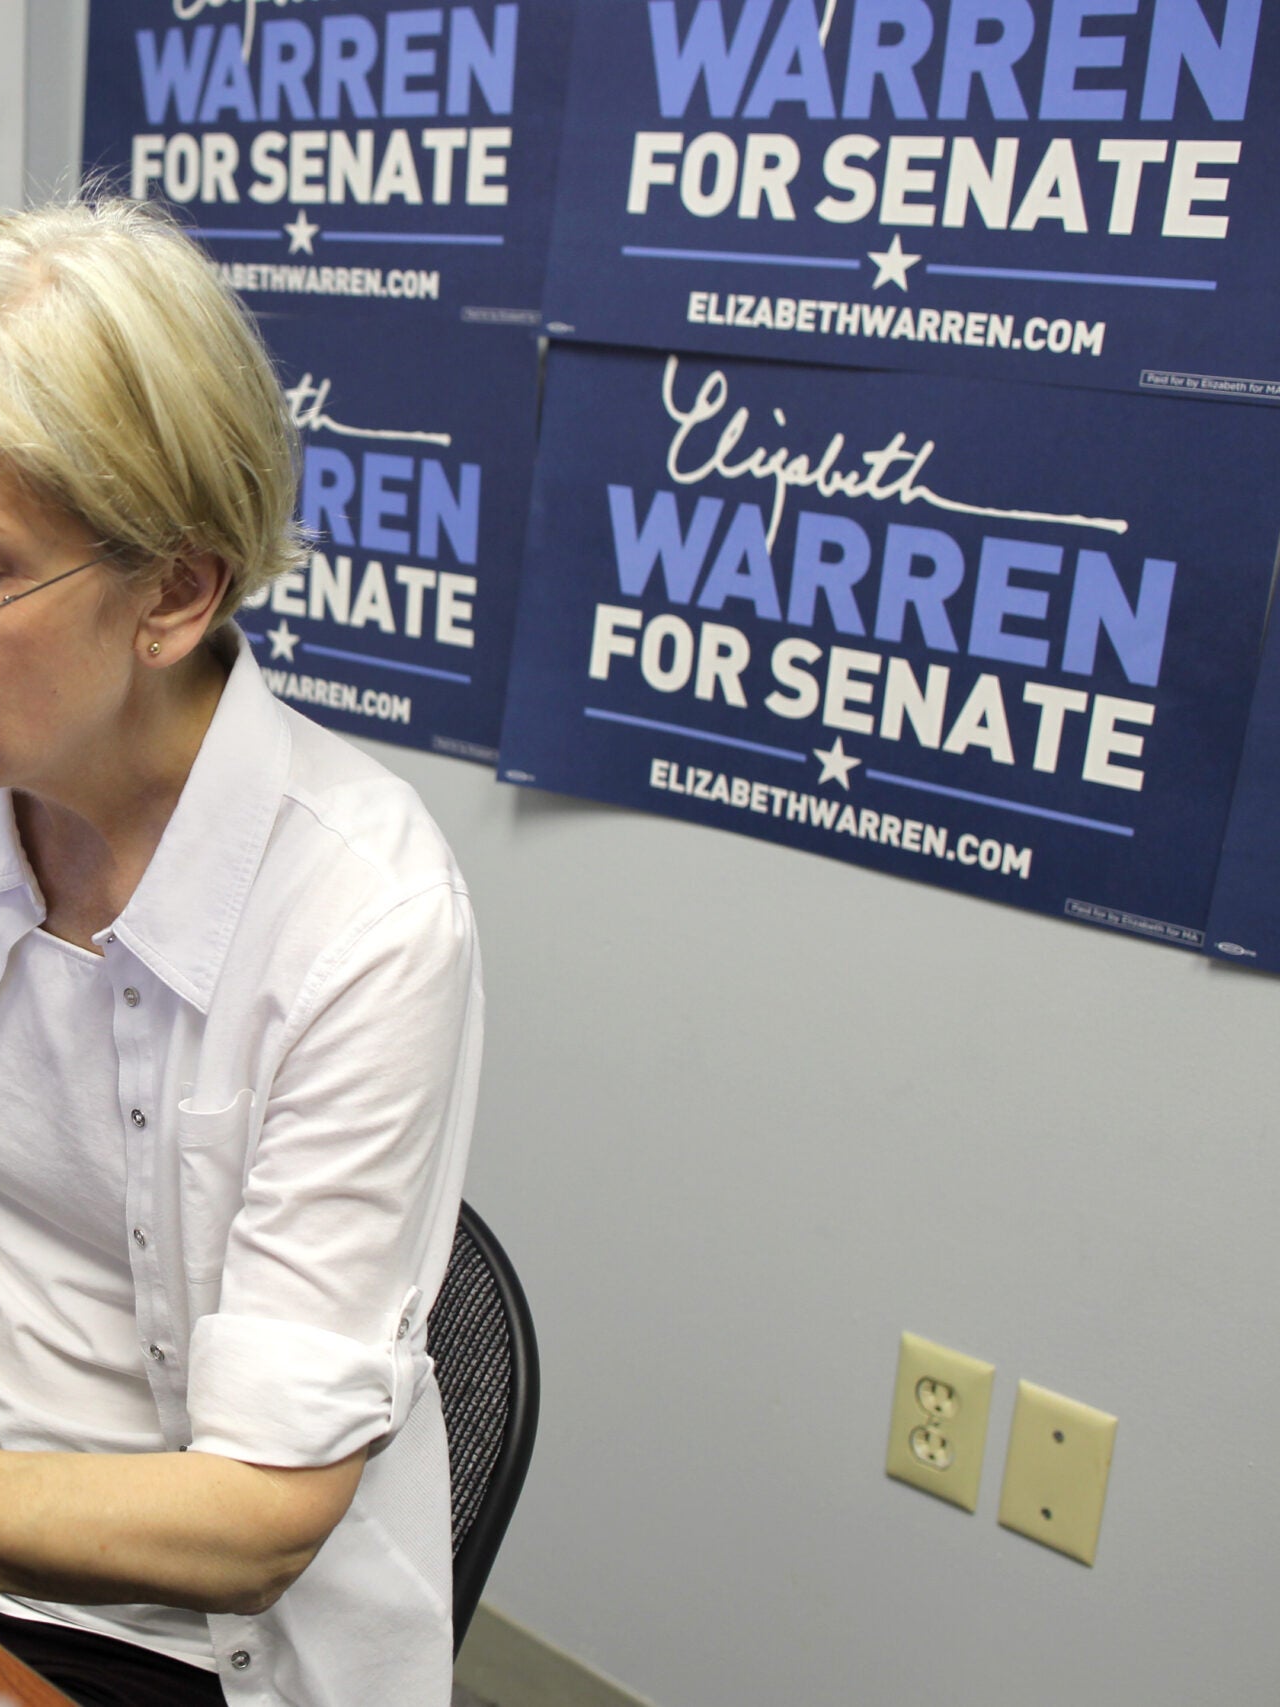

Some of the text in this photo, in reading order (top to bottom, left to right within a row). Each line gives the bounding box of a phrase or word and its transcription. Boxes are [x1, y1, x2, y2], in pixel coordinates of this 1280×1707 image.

[136, 3, 518, 125] WARREN
[648, 0, 1263, 121] WARREN
[131, 127, 512, 206] FOR SENATE
[627, 131, 1242, 238] FOR SENATE
[216, 262, 440, 299] ABETHWARREN.COM
[687, 291, 1106, 357] ELIZABETHWARREN.COM
[300, 445, 482, 566] REN
[240, 551, 478, 649] ENATE
[607, 484, 1177, 688] WARREN
[261, 666, 412, 725] WARREN.COM
[589, 602, 1157, 792] FOR SENATE
[649, 759, 1034, 880] ELIZABETHWARREN.COM
